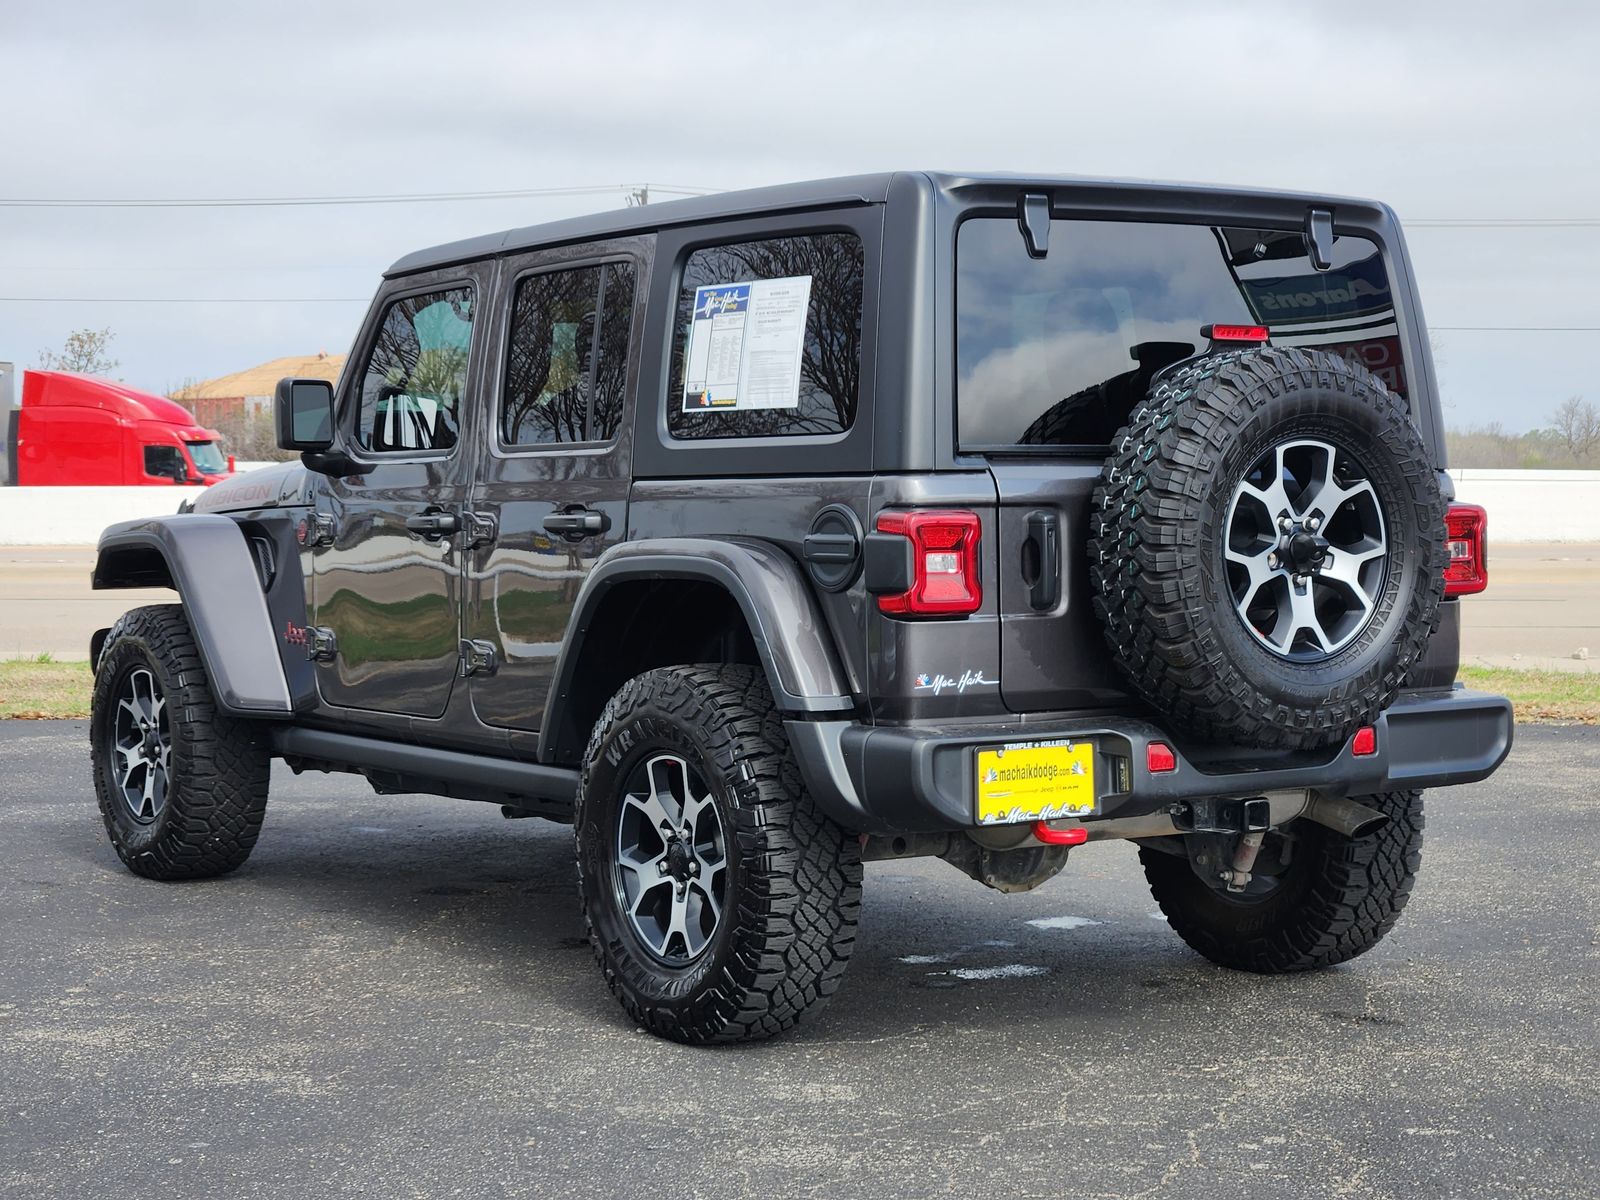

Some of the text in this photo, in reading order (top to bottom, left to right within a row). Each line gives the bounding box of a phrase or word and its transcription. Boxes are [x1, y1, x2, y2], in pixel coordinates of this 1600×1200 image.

[927, 669, 992, 696] Mac Haik
[1003, 739, 1071, 750] TEMPLE KILLEEN
[999, 763, 1071, 782] machaikdodge.com
[1006, 802, 1074, 825] Mac Haik
